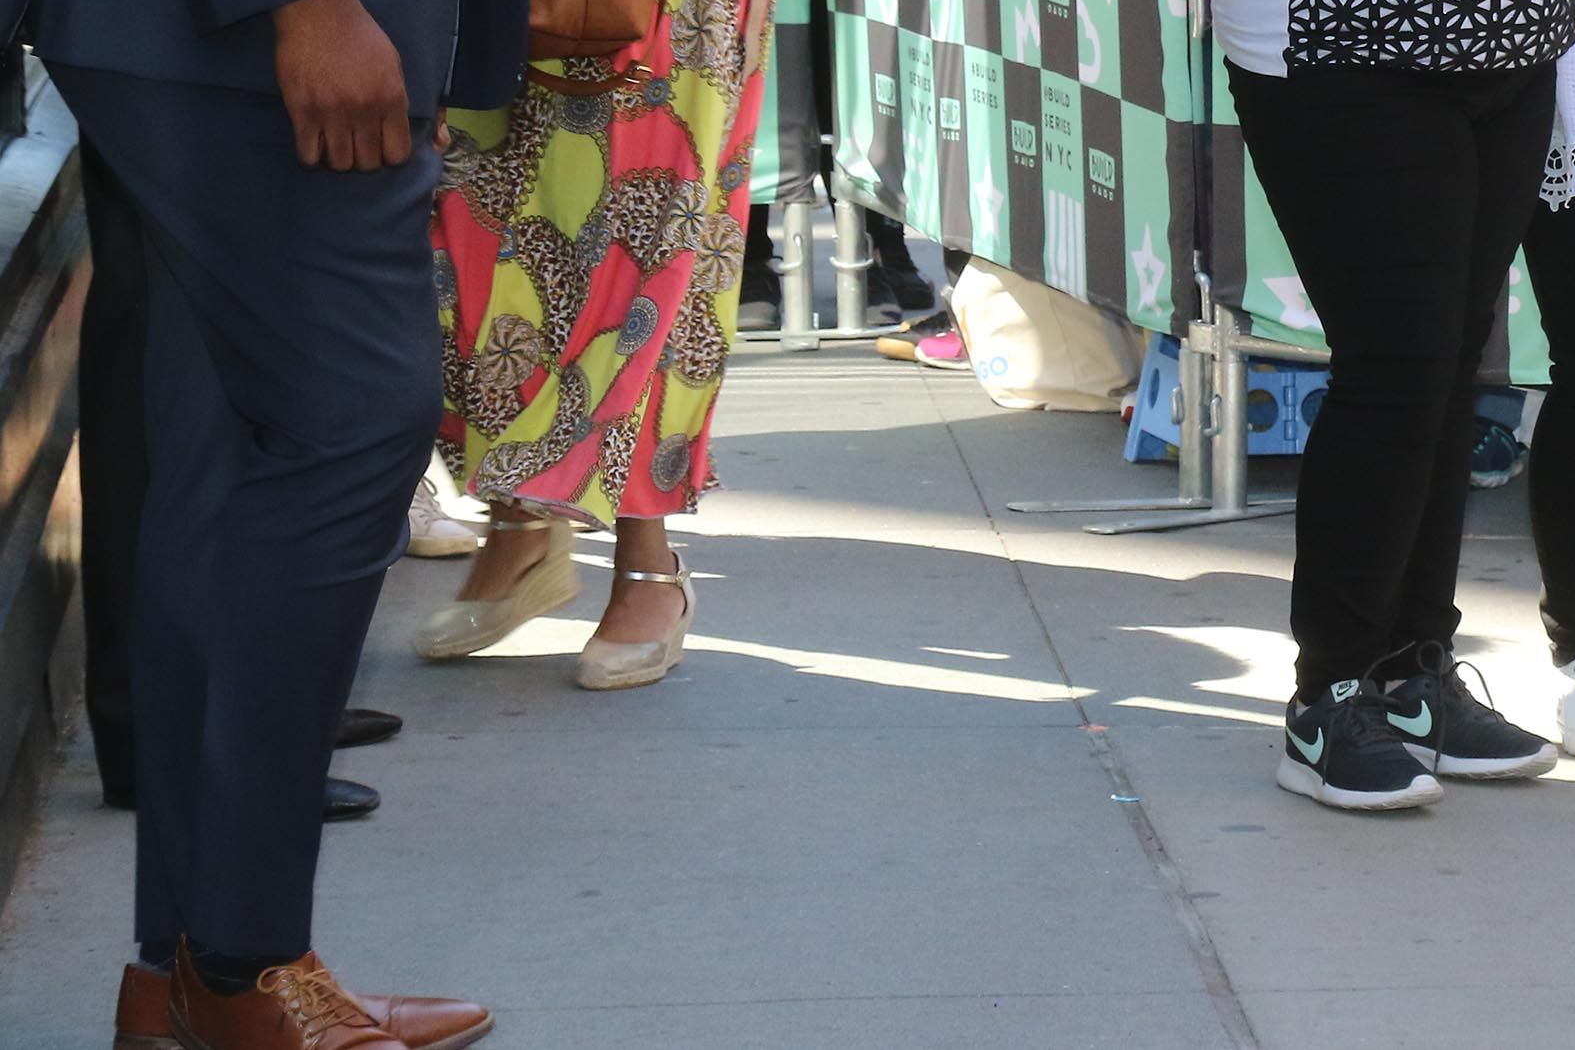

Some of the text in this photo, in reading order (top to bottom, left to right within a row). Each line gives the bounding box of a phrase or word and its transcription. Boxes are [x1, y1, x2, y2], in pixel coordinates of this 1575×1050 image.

[908, 71, 931, 93] SERIES
[910, 97, 933, 125] NYC
[972, 88, 999, 110] SERIES
[1044, 113, 1071, 137] SERIES
[1044, 141, 1072, 171] NYC
[1091, 154, 1113, 183] BUILD
